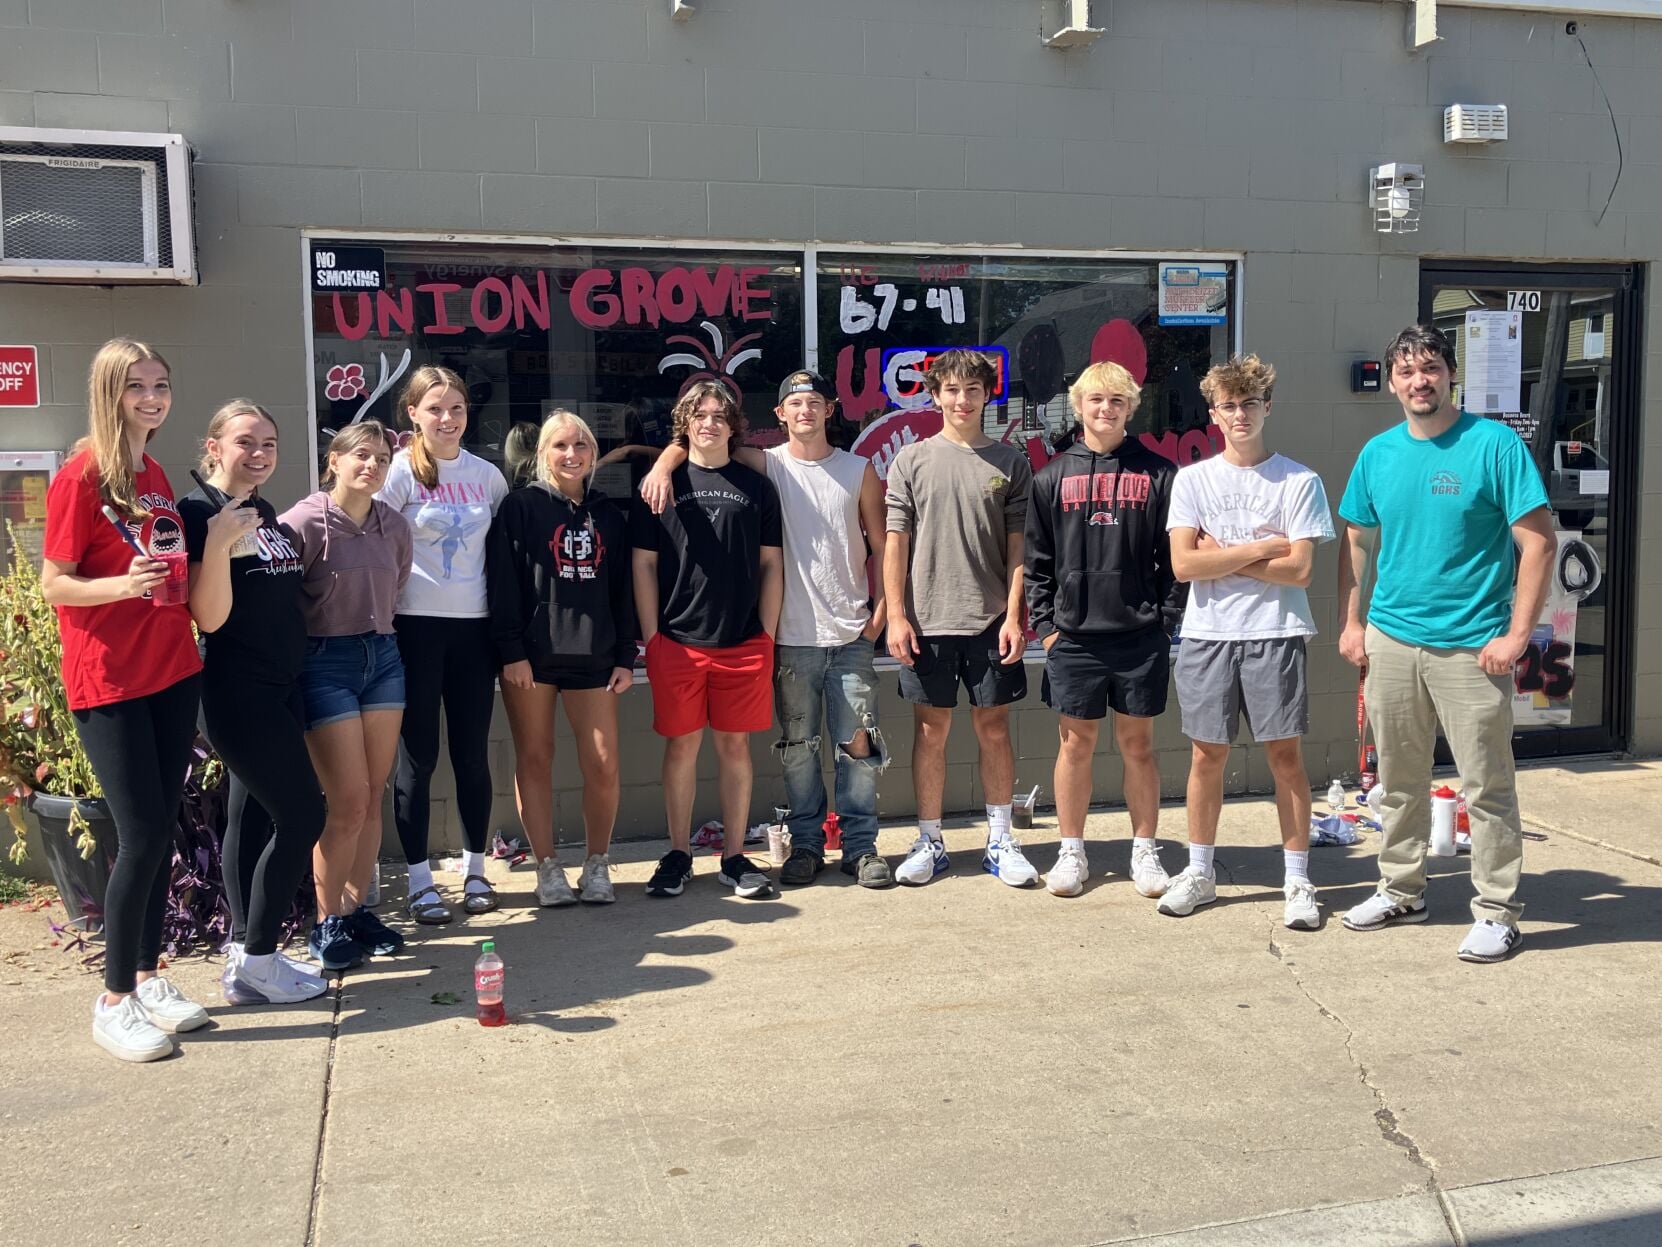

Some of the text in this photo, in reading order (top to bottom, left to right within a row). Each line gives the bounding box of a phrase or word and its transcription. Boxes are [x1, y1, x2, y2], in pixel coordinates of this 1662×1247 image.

[48, 159, 100, 168] FRIGIDAIRE
[315, 251, 336, 269] NO
[316, 270, 380, 287] SMOKING
[332, 264, 773, 341] UNION GROVE
[1165, 304, 1199, 312] CENTER
[1508, 292, 1540, 311] 740
[0, 361, 33, 376] NCY
[0, 378, 24, 391] OFF
[1431, 485, 1460, 495] UGHS
[722, 491, 751, 507] EAGLE
[1063, 500, 1145, 512] BAEBALL
